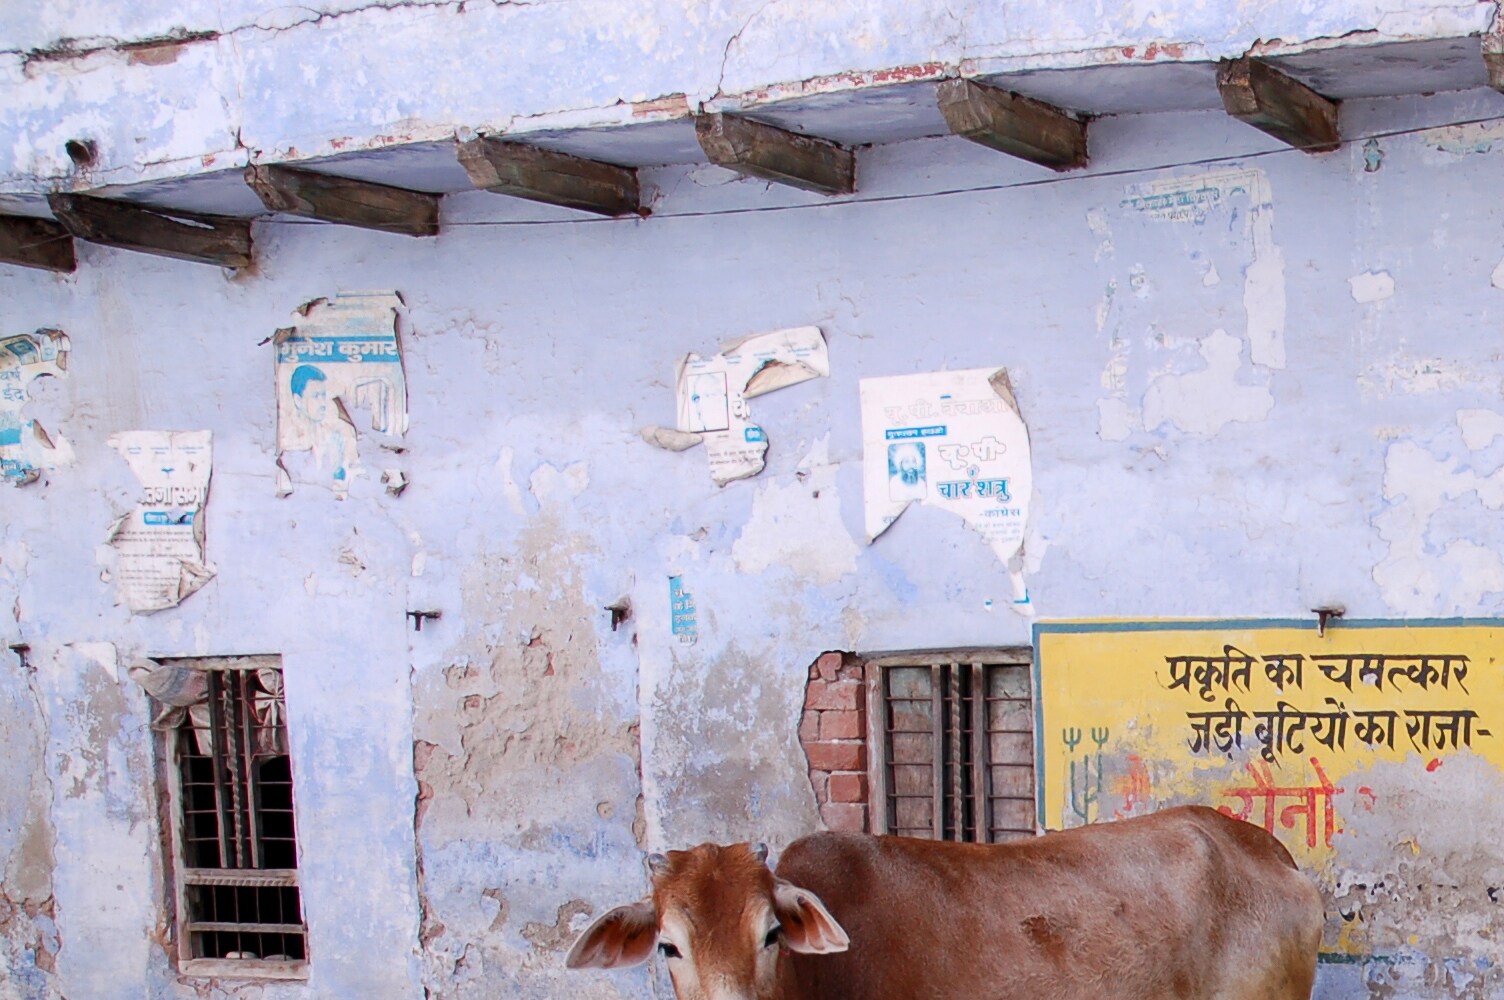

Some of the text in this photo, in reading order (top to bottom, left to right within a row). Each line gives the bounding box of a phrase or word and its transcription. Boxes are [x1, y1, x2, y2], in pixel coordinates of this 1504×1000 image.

[338, 340, 397, 363] कुमार
[937, 477, 1013, 503] चार शत्रु
[1165, 644, 1470, 702] प्रकृति का चमत्कार
[1353, 710, 1400, 750] का
